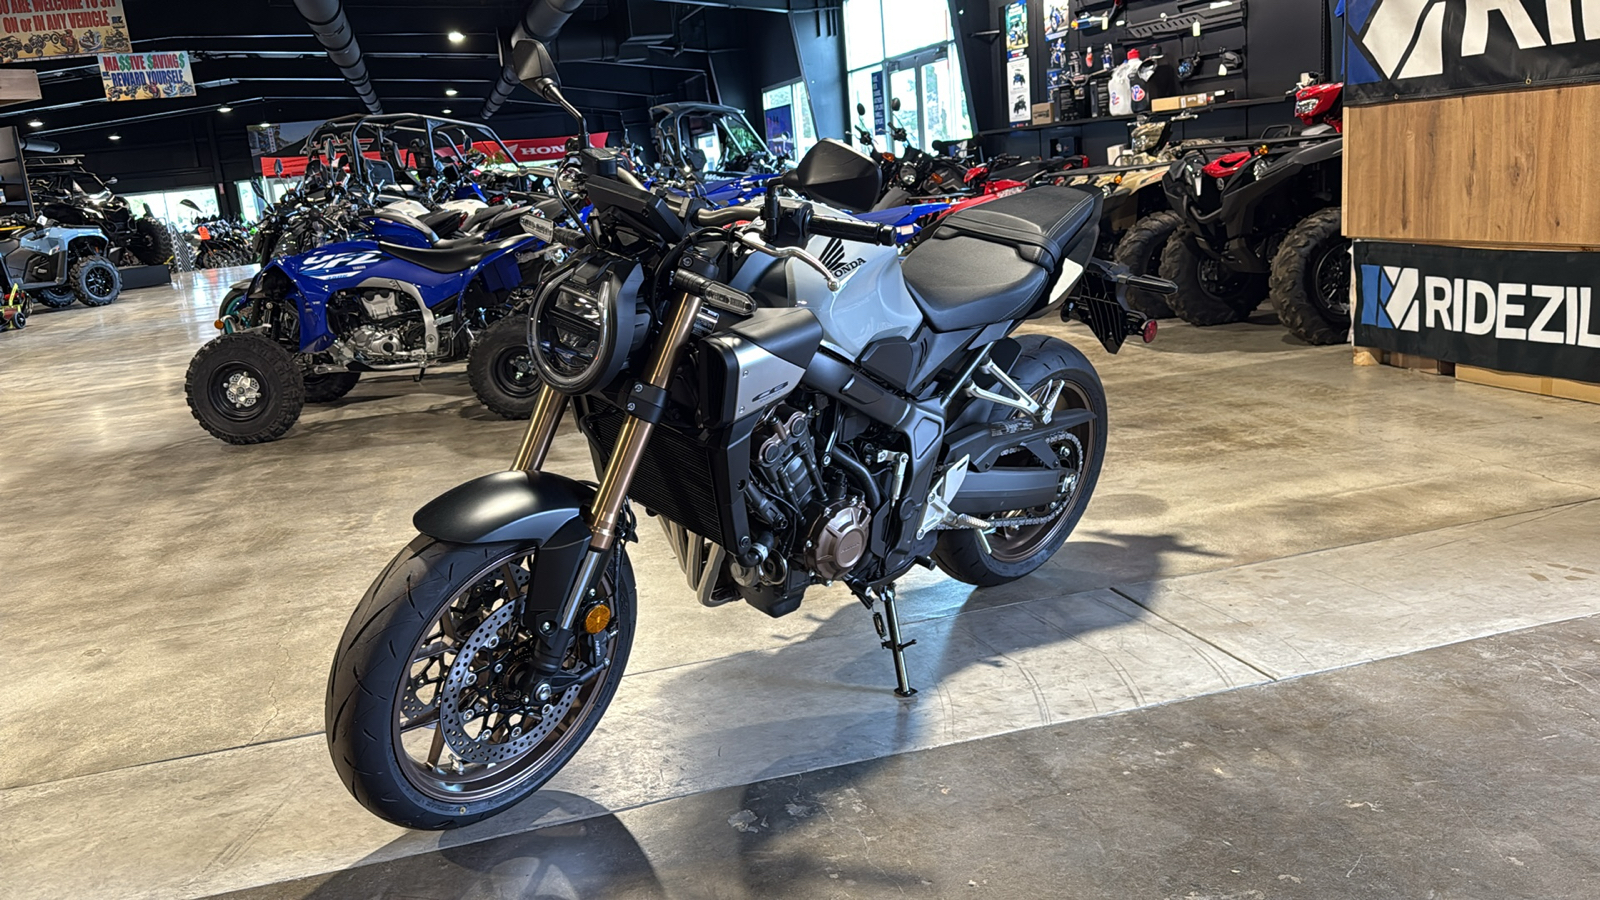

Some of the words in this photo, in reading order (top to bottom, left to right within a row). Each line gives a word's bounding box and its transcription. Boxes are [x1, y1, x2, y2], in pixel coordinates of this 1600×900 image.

[3, 17, 19, 33] ON
[33, 15, 46, 31] IN
[46, 13, 67, 30] ANY
[67, 10, 110, 29] VEHICLE
[111, 71, 147, 87] REWARD
[146, 70, 183, 86] YOURSELF
[831, 258, 867, 278] ONDA
[1425, 275, 1600, 348] RIDEZIL
